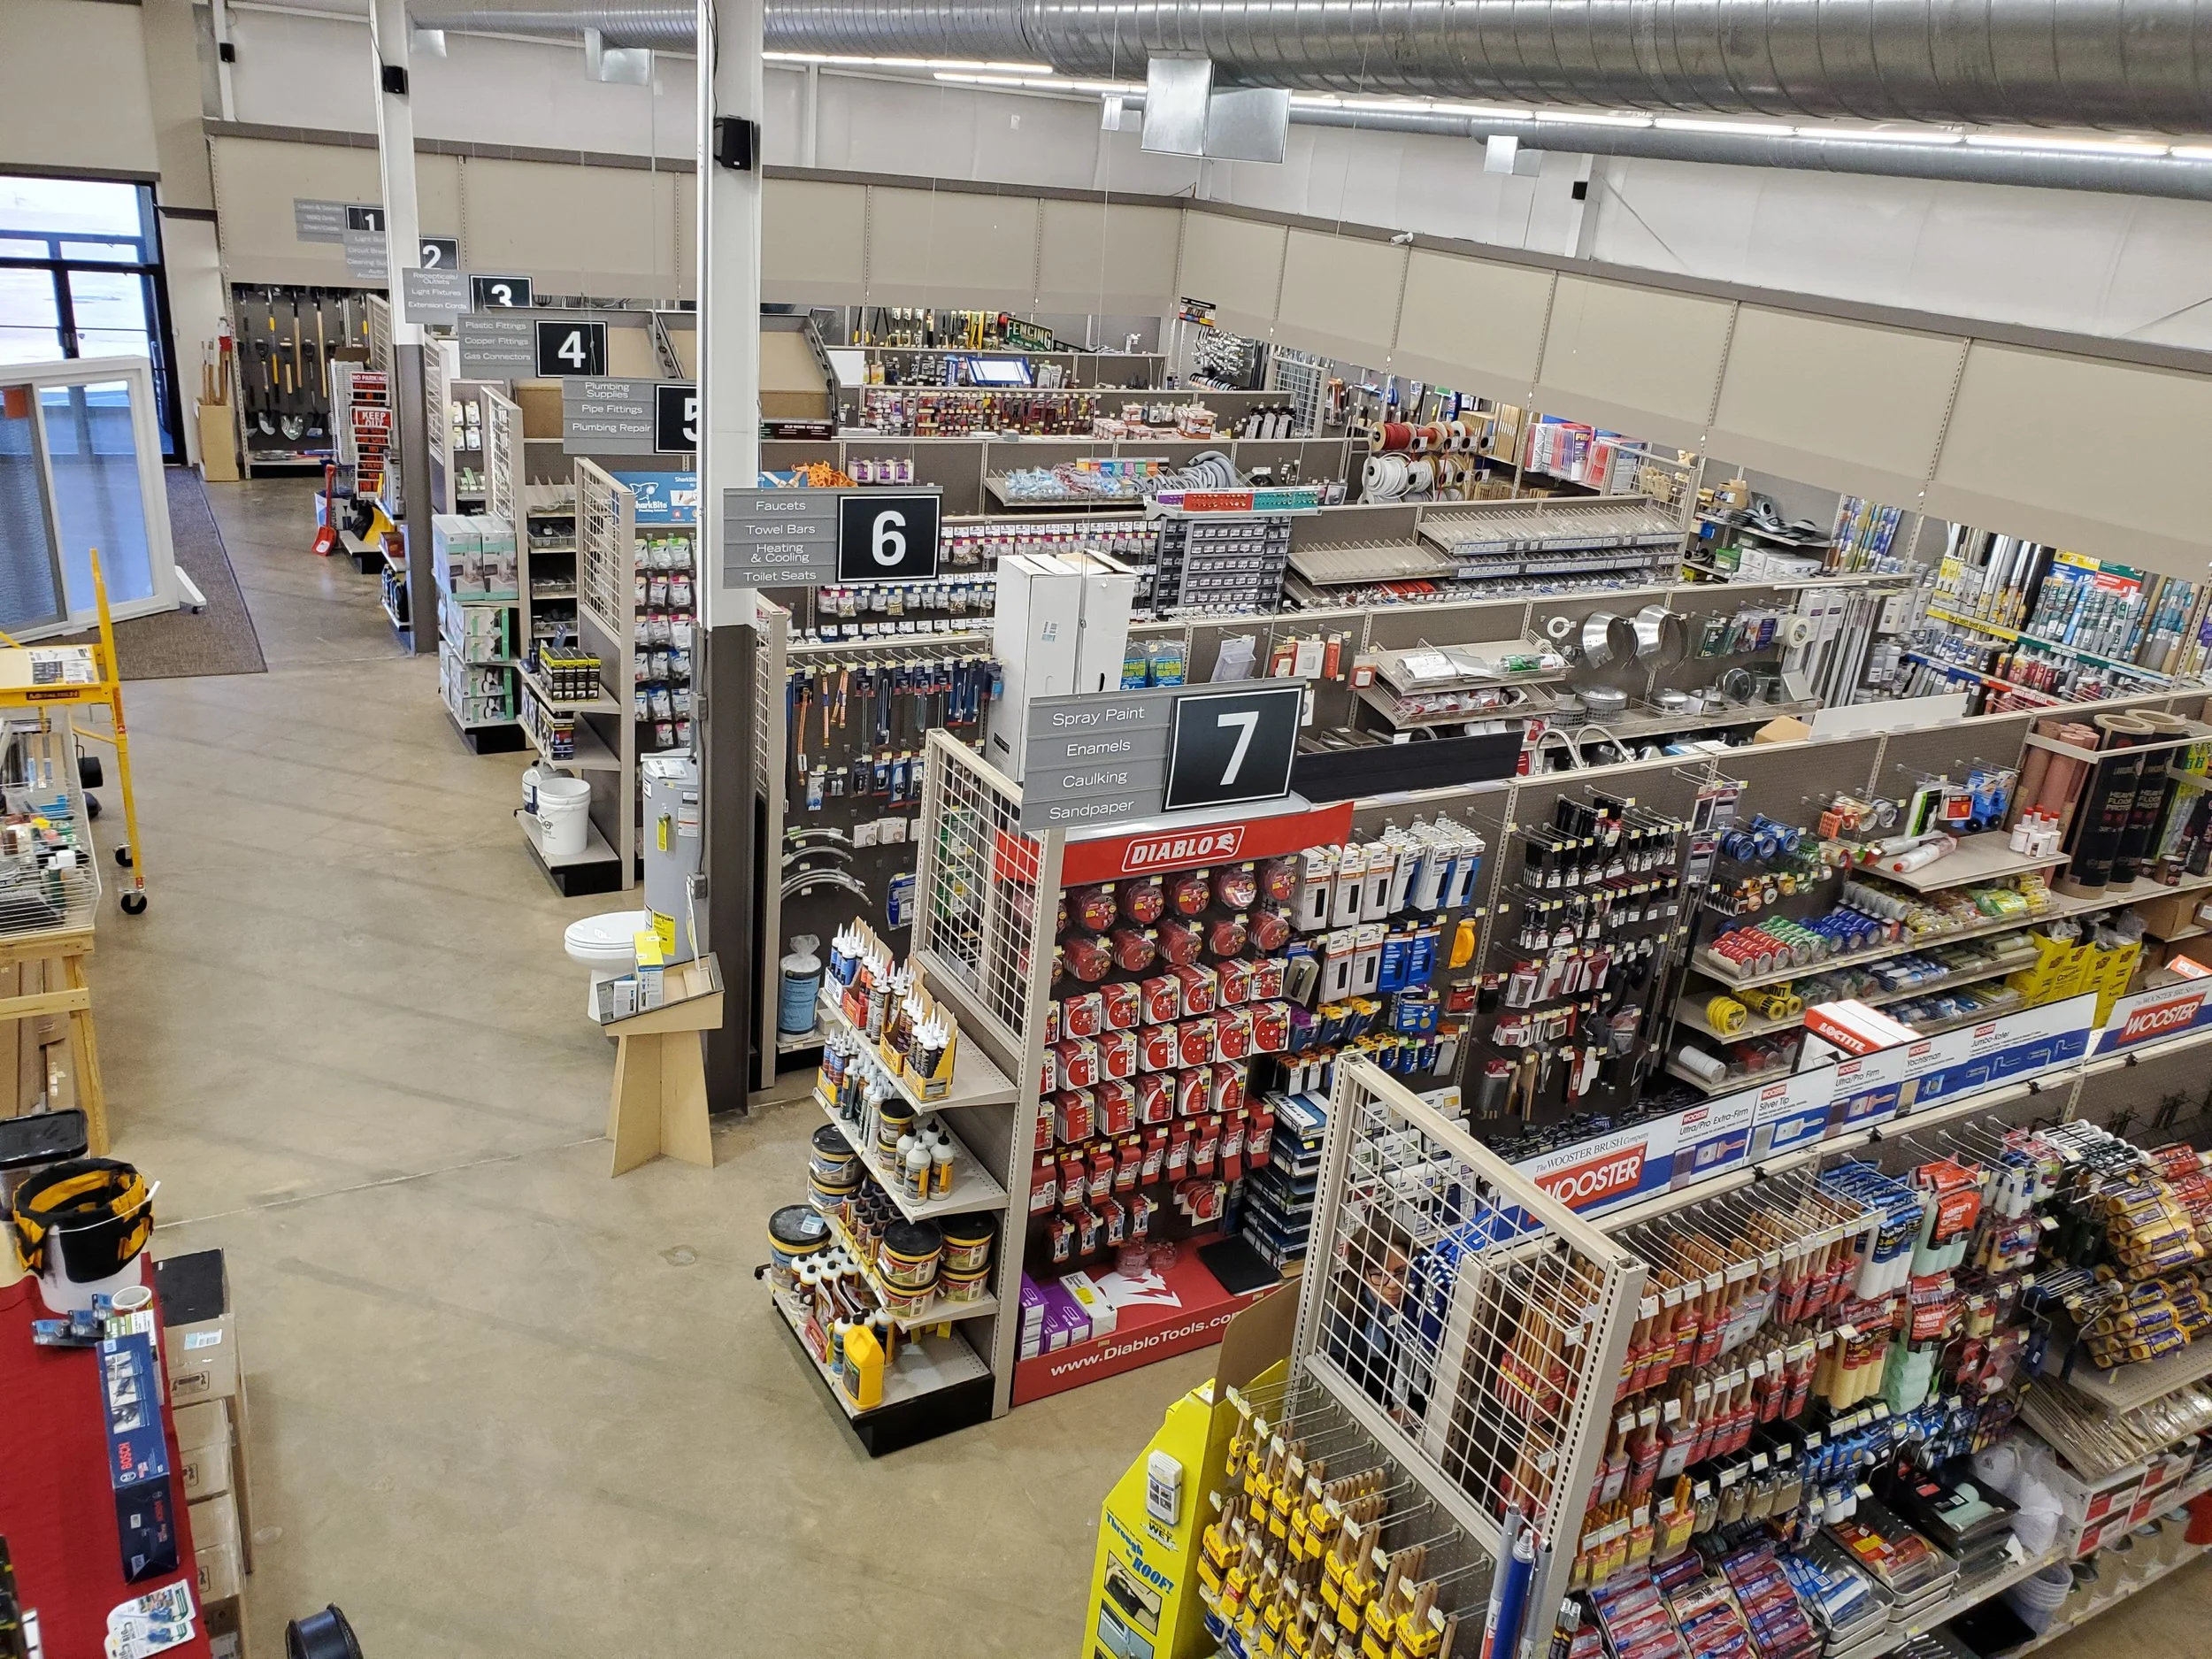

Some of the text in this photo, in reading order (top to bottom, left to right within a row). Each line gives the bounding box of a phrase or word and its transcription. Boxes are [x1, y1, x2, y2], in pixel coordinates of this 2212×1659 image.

[365, 213, 375, 231] 1
[423, 245, 442, 269] 2
[491, 284, 512, 306] 3
[465, 321, 527, 331] Plastic Fittings
[1007, 320, 1051, 349] FENCING
[465, 337, 529, 347] Copper Fittings
[557, 331, 586, 368] 4
[464, 352, 531, 361] Gas Connectors
[585, 381, 630, 392] Plumbing
[587, 390, 628, 400] Supplies
[582, 404, 643, 415] Pipe Fittings
[682, 397, 696, 442] 5
[572, 423, 651, 433] Plumbing Repair
[756, 500, 806, 511] Faucets
[745, 524, 816, 535] Towel Bars
[872, 511, 907, 566] 6
[757, 542, 803, 554] Heating
[750, 552, 810, 565] & Cooling
[743, 571, 817, 581] Toilet Seats
[1052, 707, 1145, 728] Spray Paint
[1066, 739, 1131, 757] Enamels
[1217, 711, 1260, 786] 7
[1063, 770, 1128, 788] Caulking
[1049, 799, 1134, 820] Sandpaper
[1131, 835, 1213, 864] DIABLO
[2126, 1001, 2200, 1035] WOOSTER
[1819, 1022, 1865, 1051] LOCTITE
[1907, 1051, 1941, 1067] Yachtsman
[1835, 1071, 1864, 1087] Ultra/Pro
[1865, 1068, 1880, 1080] Firm
[1759, 1100, 1778, 1111] Silver
[1779, 1097, 1790, 1108] Tip
[1679, 1120, 1711, 1135] Ultra/Pro
[1713, 1108, 1748, 1125] Extra-Firm
[1683, 1109, 1709, 1124] WOOSTER
[1535, 1133, 1648, 1173] The WOOSTER BRUSH Company
[119, 1441, 133, 1470] BOSCH
[1105, 1511, 1144, 1557] Through
[1148, 1523, 1171, 1543] WET
[1132, 1555, 1175, 1594] ROOF!
[1367, 1612, 1386, 1636] Purdy
[1397, 1625, 1417, 1651] Purdy
